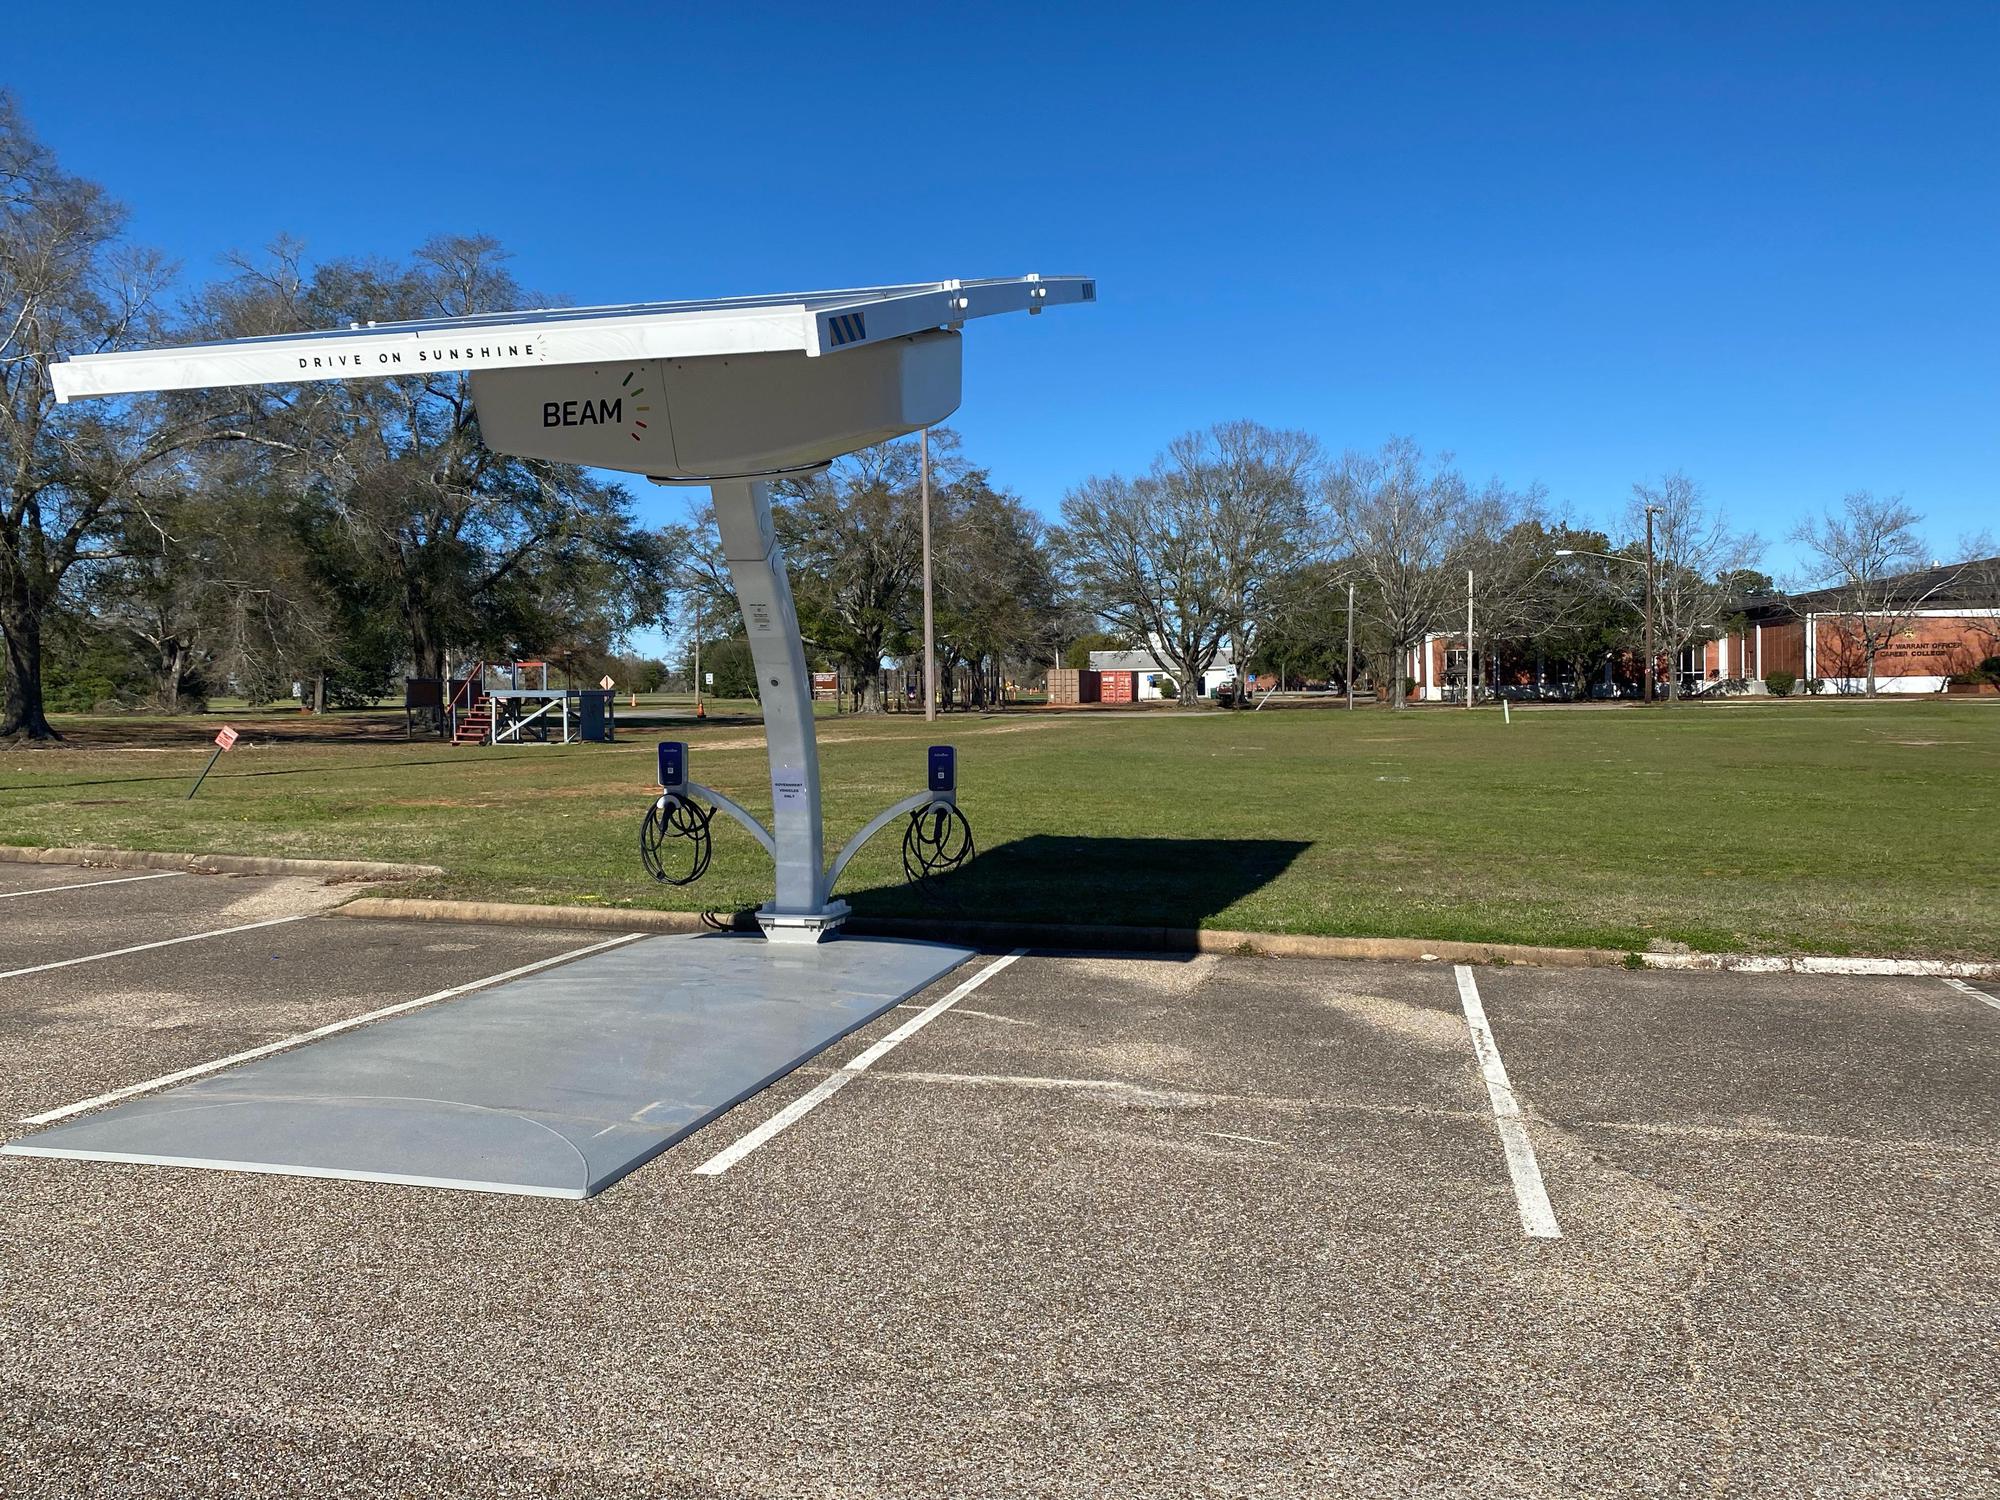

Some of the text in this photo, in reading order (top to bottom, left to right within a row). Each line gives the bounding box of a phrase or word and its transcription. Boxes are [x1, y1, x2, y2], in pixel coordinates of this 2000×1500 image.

[299, 344, 534, 368] DRIVE ON SUNSHINE
[543, 398, 622, 428] BEAM
